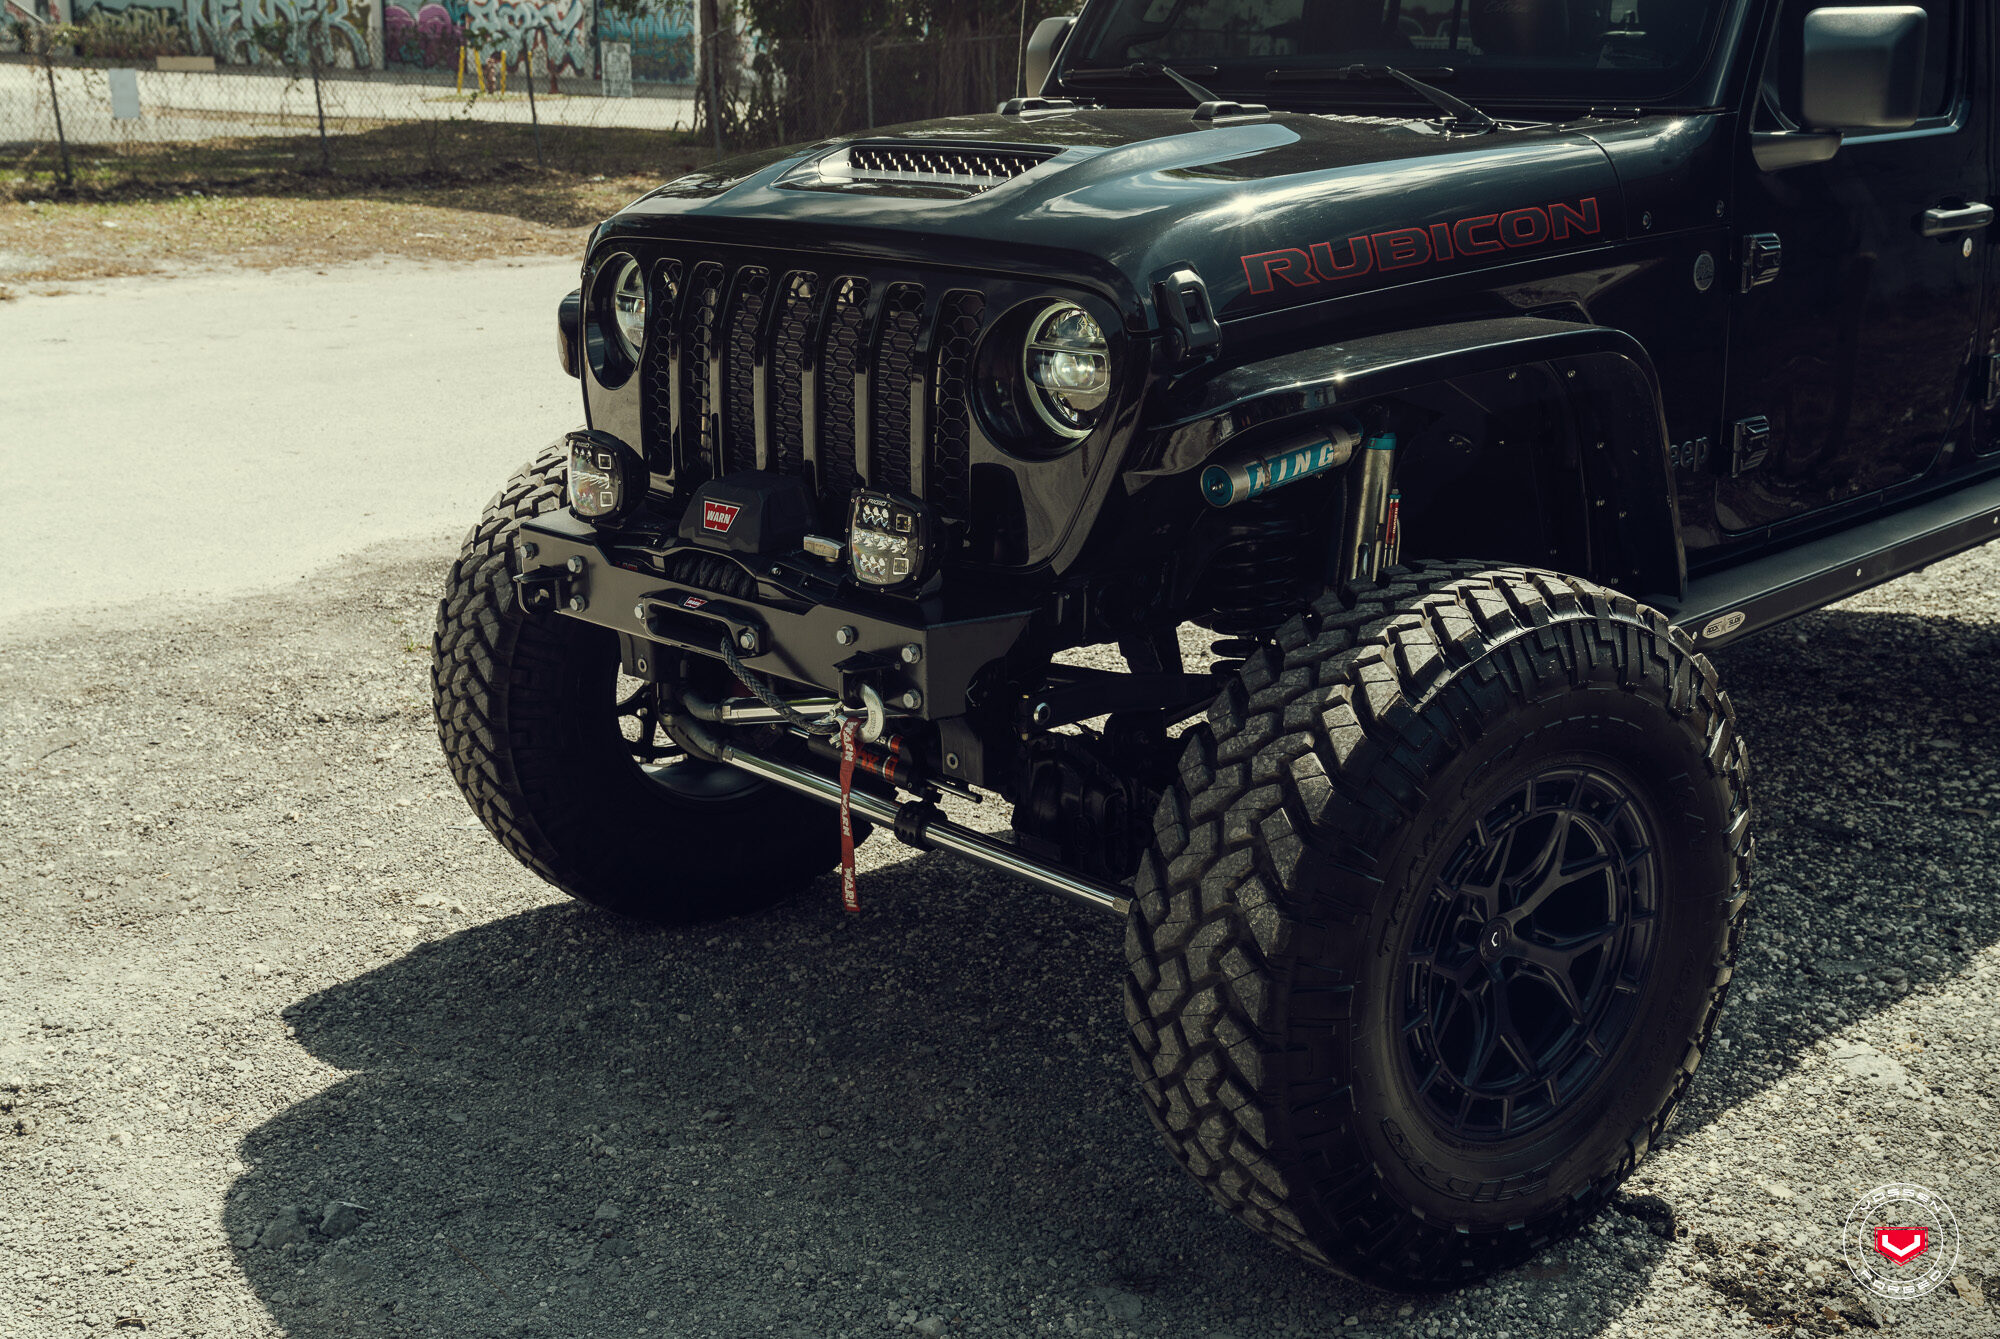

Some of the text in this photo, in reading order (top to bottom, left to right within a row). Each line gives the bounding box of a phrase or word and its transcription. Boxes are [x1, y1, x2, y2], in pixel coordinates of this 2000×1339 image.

[1241, 197, 1600, 295] RUBICON
[1669, 436, 1707, 472] eep
[706, 510, 731, 524] WARN
[842, 721, 858, 762] WARN
[841, 793, 851, 837] WARN
